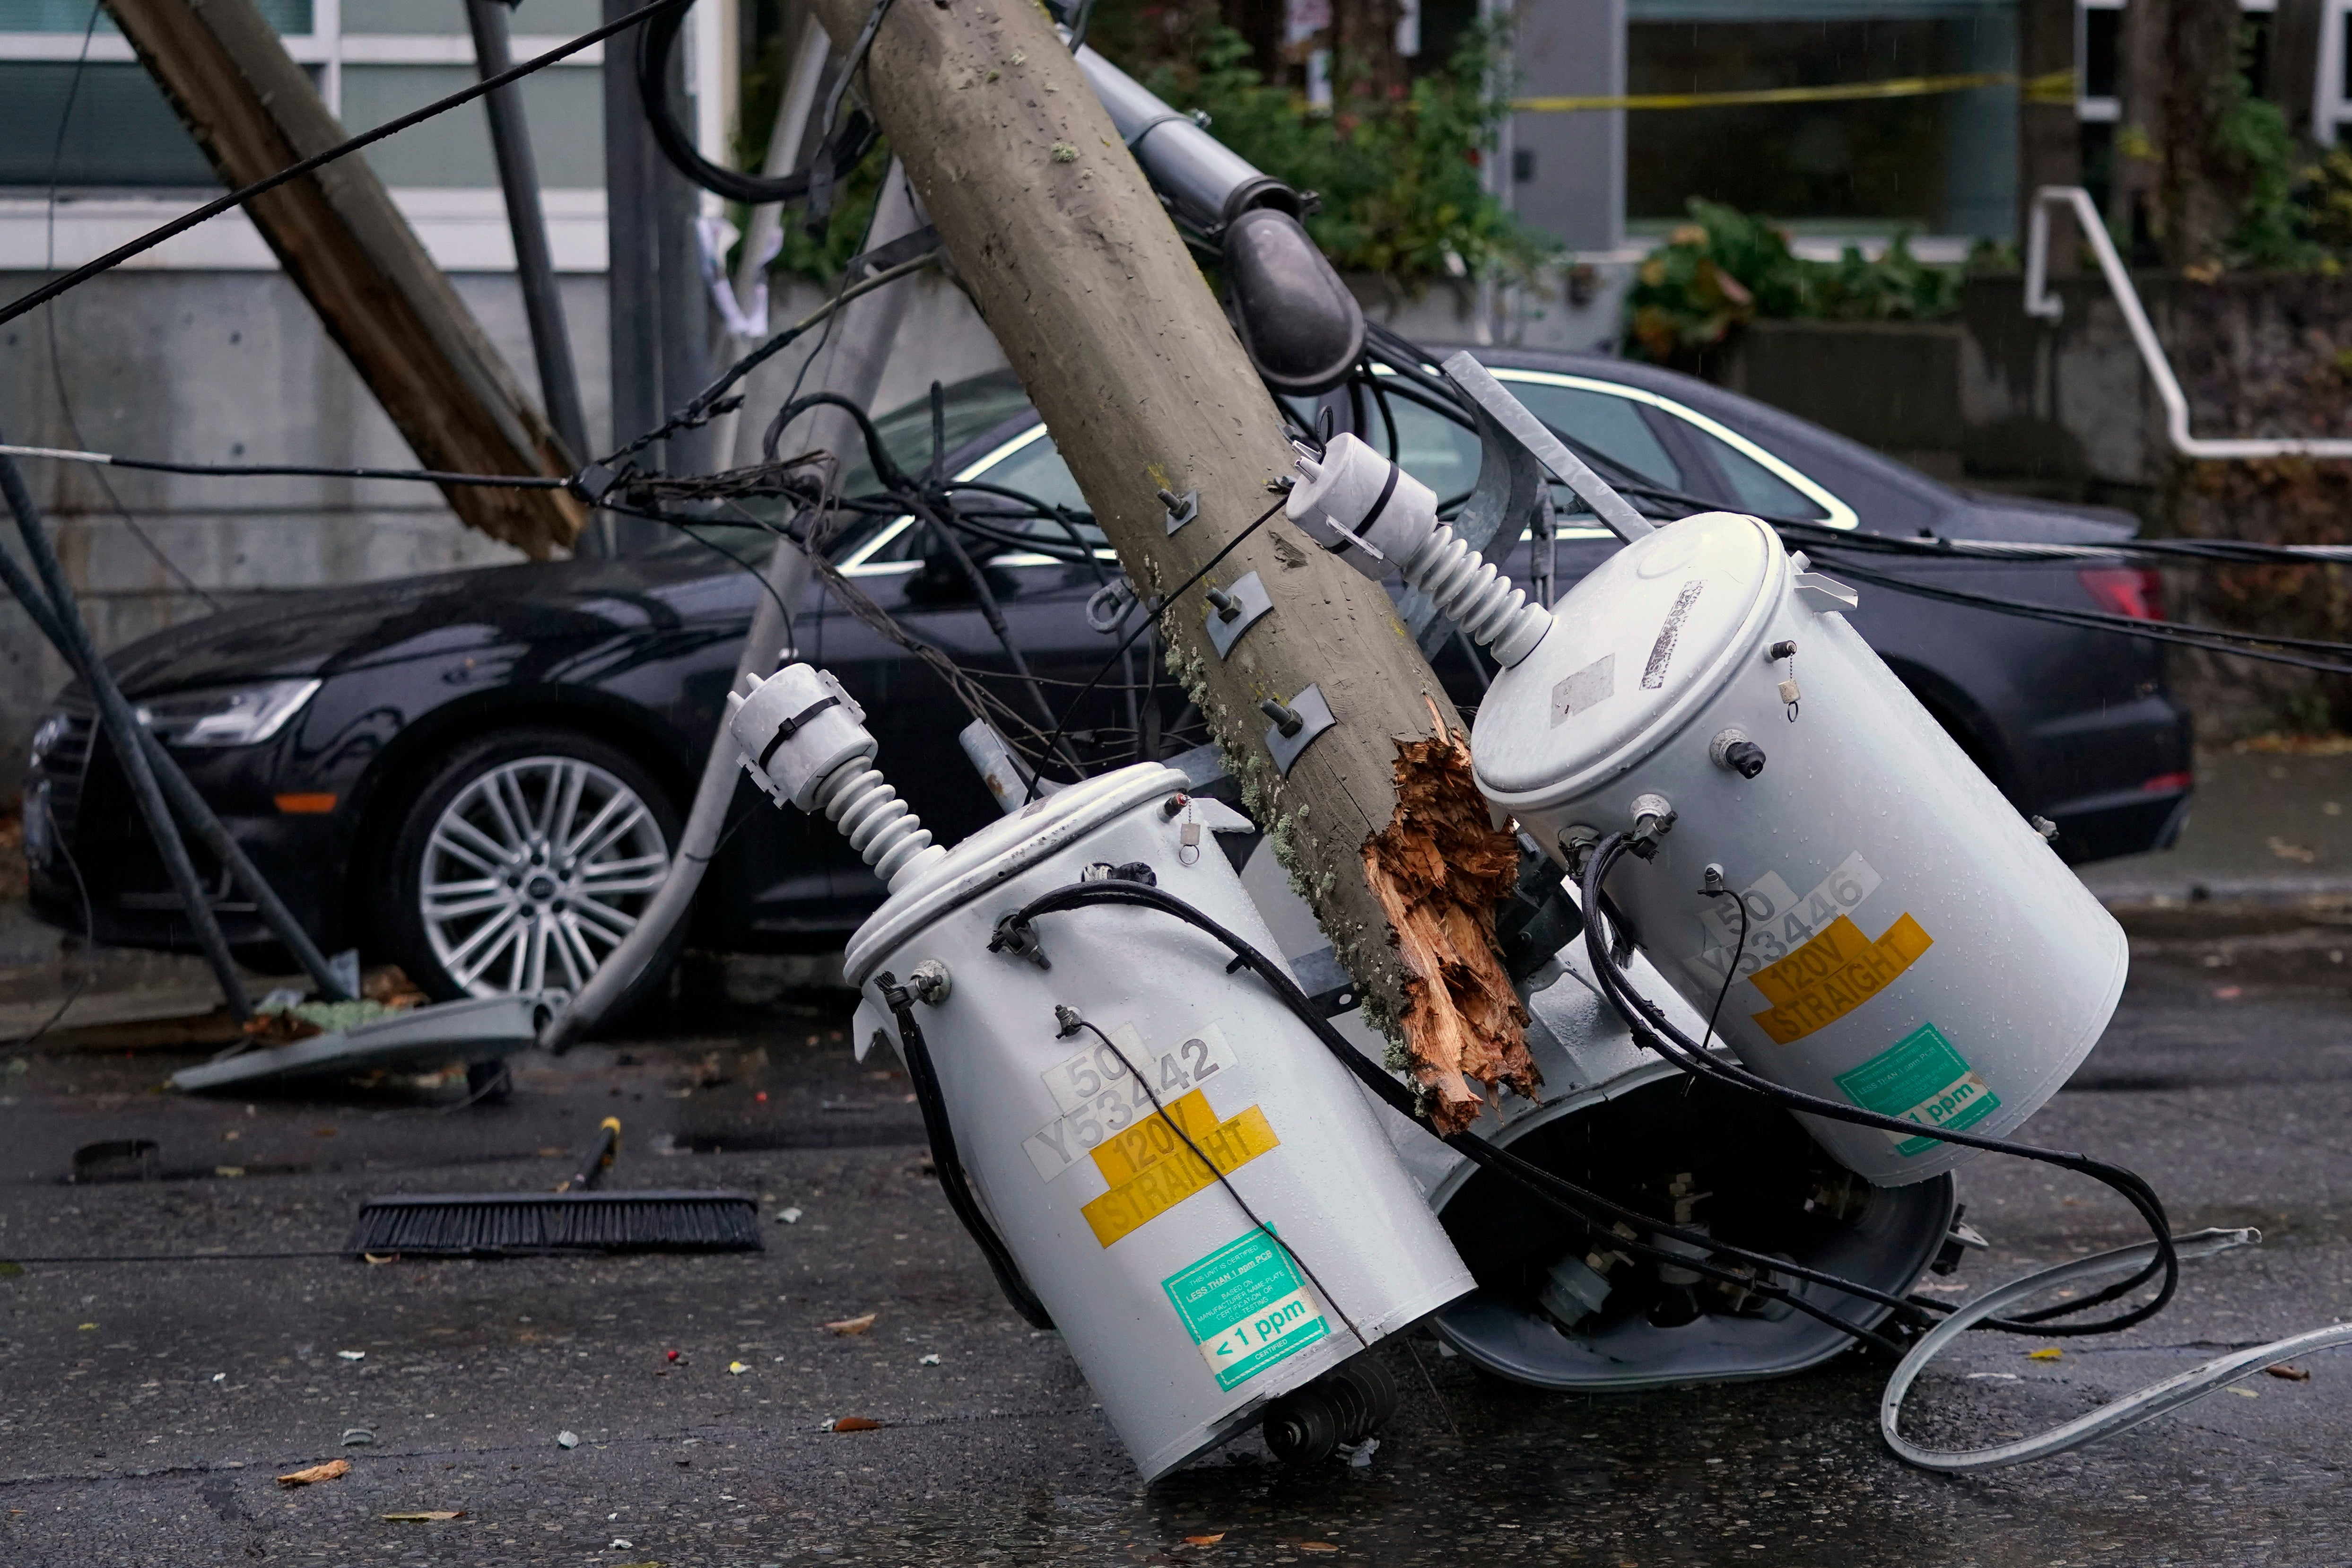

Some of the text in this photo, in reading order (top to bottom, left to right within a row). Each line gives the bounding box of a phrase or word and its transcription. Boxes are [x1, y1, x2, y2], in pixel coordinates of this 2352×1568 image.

[1696, 871, 1863, 982] Y53446
[1715, 890, 1775, 935] 50
[1770, 931, 1844, 992] 120V
[1771, 932, 1908, 1037] STRAIGHT
[1065, 1042, 1128, 1098] 50
[1857, 1082, 1877, 1095] LESS
[1036, 1038, 1220, 1164] Y53442
[1926, 1083, 1975, 1122] ppm
[1102, 1119, 1251, 1229] STRAIGHT
[1186, 1286, 1208, 1303] LESS
[1207, 1272, 1231, 1289] THAN
[1237, 1261, 1256, 1275] ppm
[1255, 1250, 1273, 1264] PCB
[1189, 1275, 1204, 1286] THIS
[1204, 1266, 1219, 1278] UNIT
[1227, 1245, 1259, 1265] CERTIFIED
[1197, 1270, 1285, 1322] MANUFACTURER NAME-PLATE
[1216, 1285, 1273, 1320] CERTIFICATION OR
[1221, 1279, 1254, 1300] BASED ON
[1242, 1296, 1269, 1315] TESTING
[1234, 1327, 1249, 1346] 1
[1254, 1300, 1306, 1342] ppm
[1254, 1339, 1288, 1360] CERTIFIED
